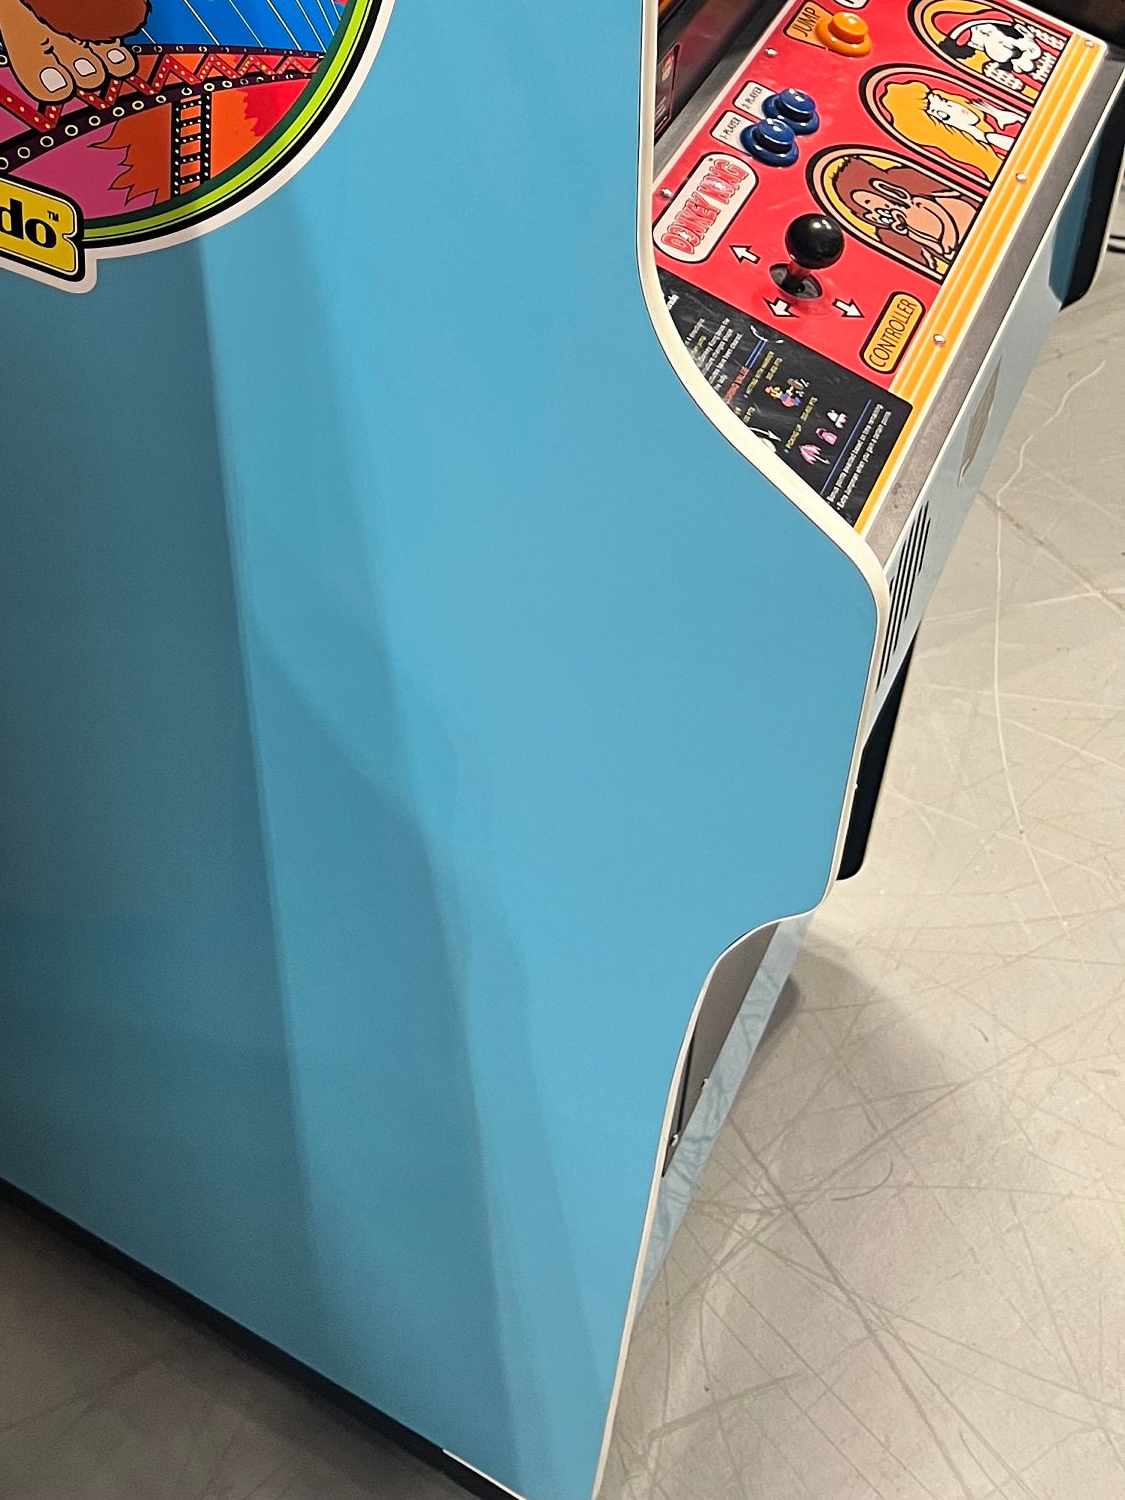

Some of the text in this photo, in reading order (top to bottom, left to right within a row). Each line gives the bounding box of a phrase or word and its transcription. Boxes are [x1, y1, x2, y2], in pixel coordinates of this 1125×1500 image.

[791, 6, 820, 38] JUMP
[661, 158, 750, 255] DONKEY KONG
[869, 298, 917, 368] CONTROLLER
